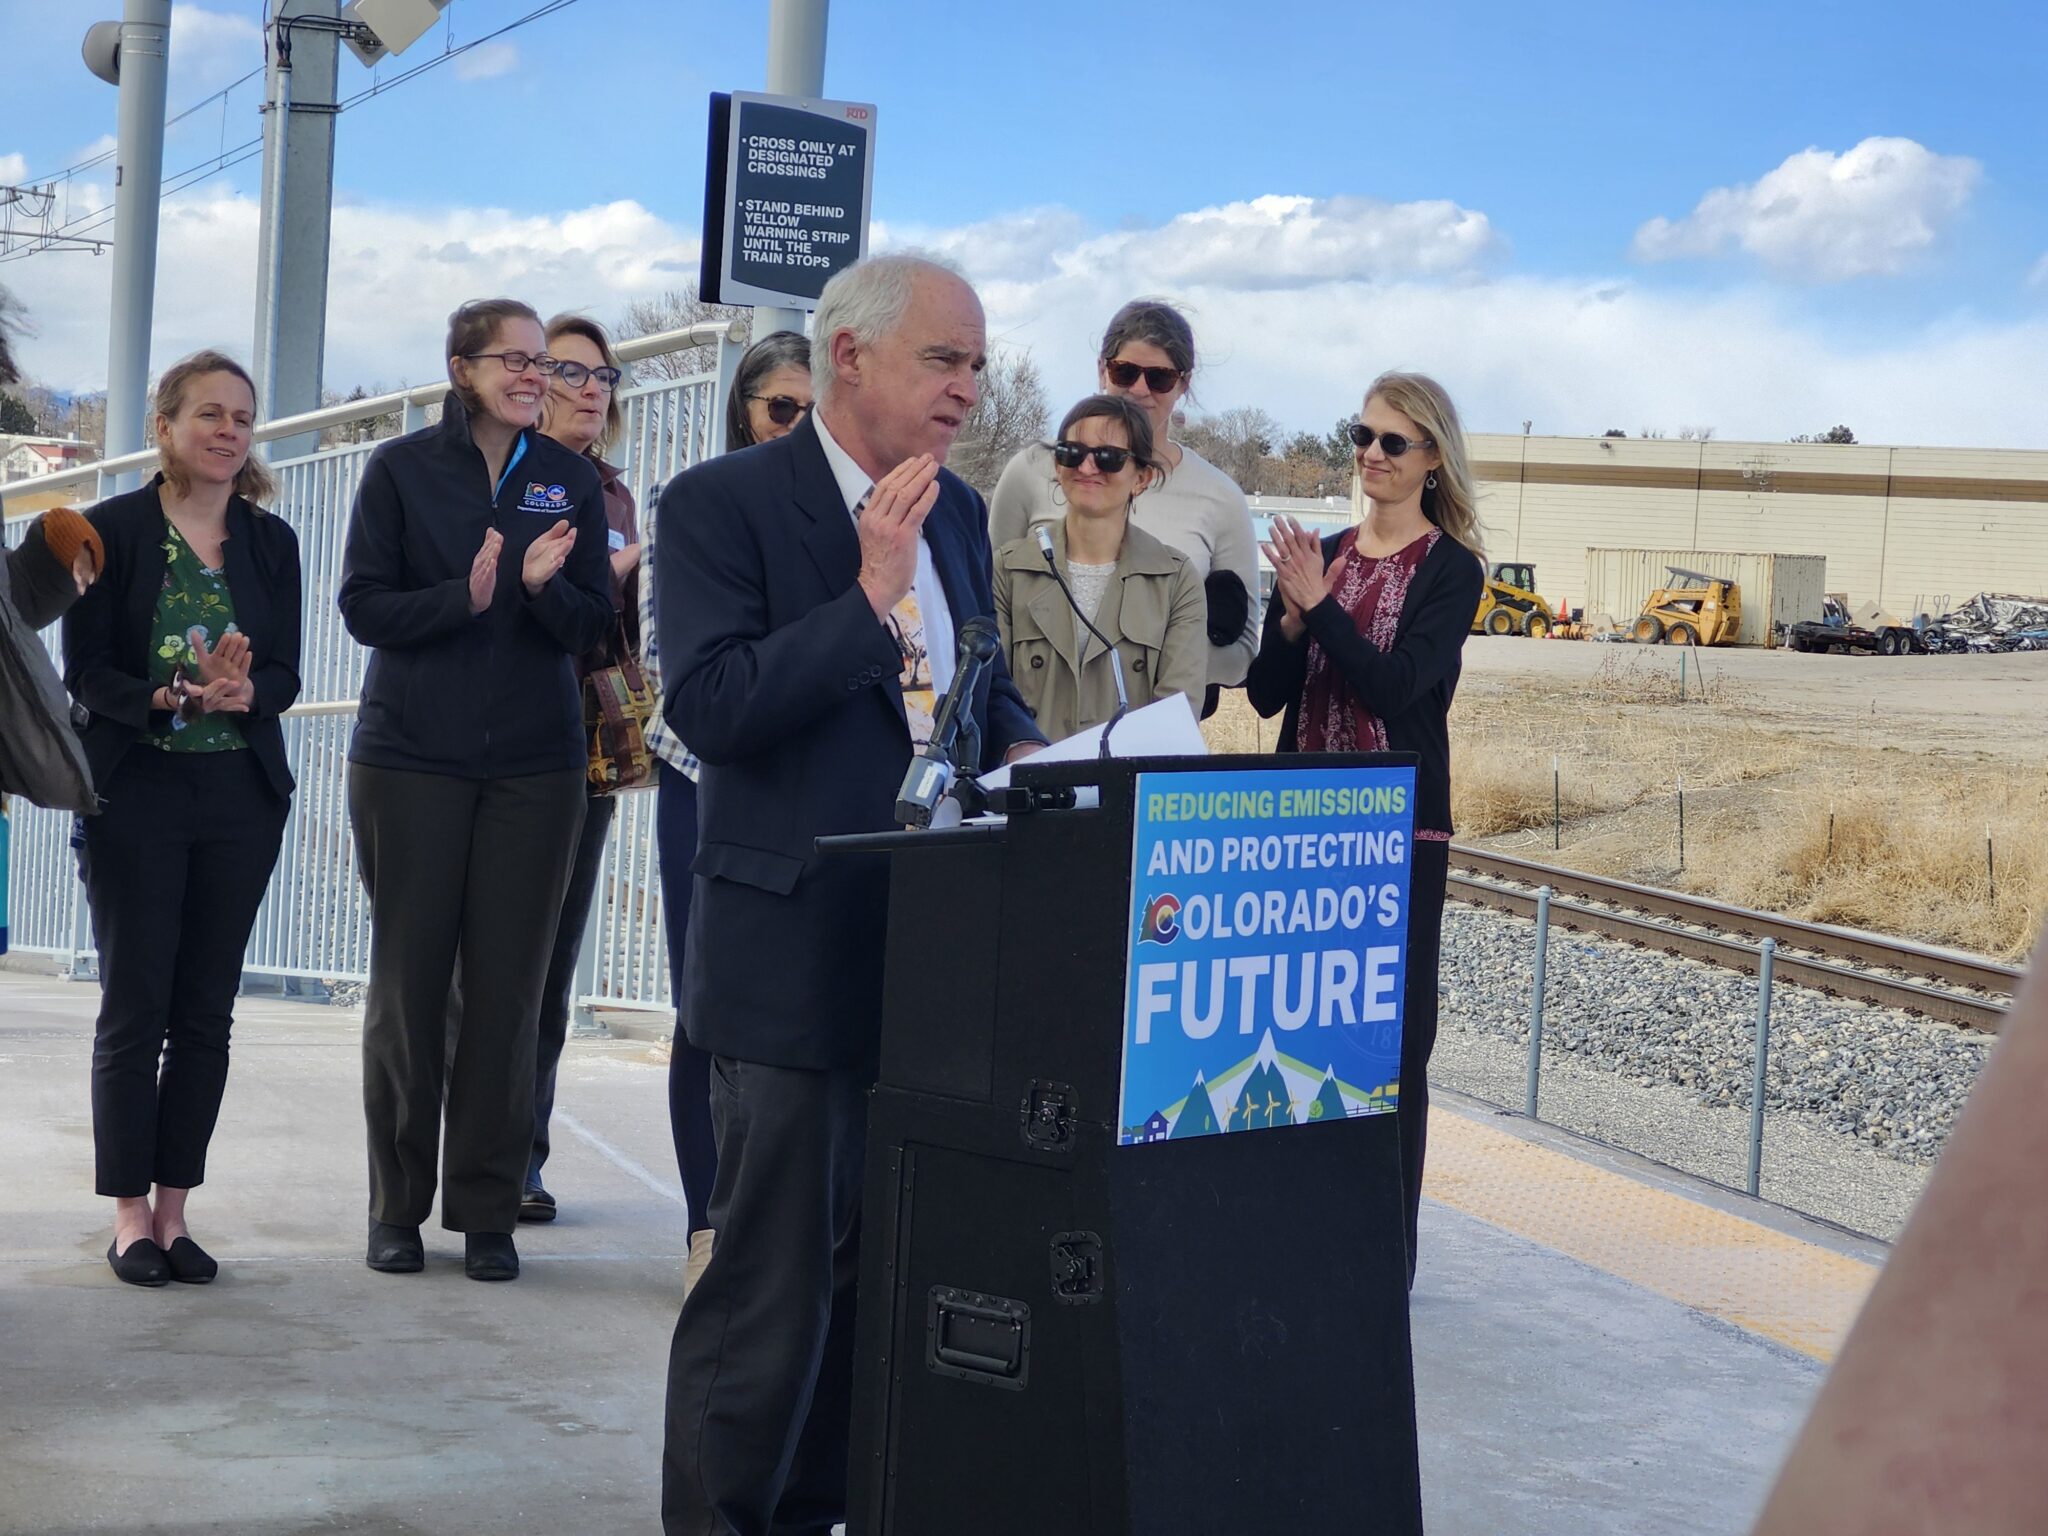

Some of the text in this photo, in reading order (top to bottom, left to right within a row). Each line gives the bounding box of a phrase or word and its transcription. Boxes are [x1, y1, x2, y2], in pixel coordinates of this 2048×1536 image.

[749, 135, 856, 156] CROSS ONLY AT
[748, 148, 834, 167] DESIGNATED
[747, 161, 827, 179] CROSSINGS
[745, 199, 845, 218] STAND BEHIND
[745, 212, 800, 227] YELLOW
[744, 225, 850, 244] WARNING STRIP
[743, 237, 812, 254] UNTIL THE
[742, 250, 831, 268] TRAIN STOPS
[1148, 786, 1406, 822] REDUCING EMISSIONS
[1146, 830, 1404, 876] AND PROTECTING
[1137, 883, 1400, 946] COLORADO'S
[1135, 945, 1400, 1044] FUTURE
